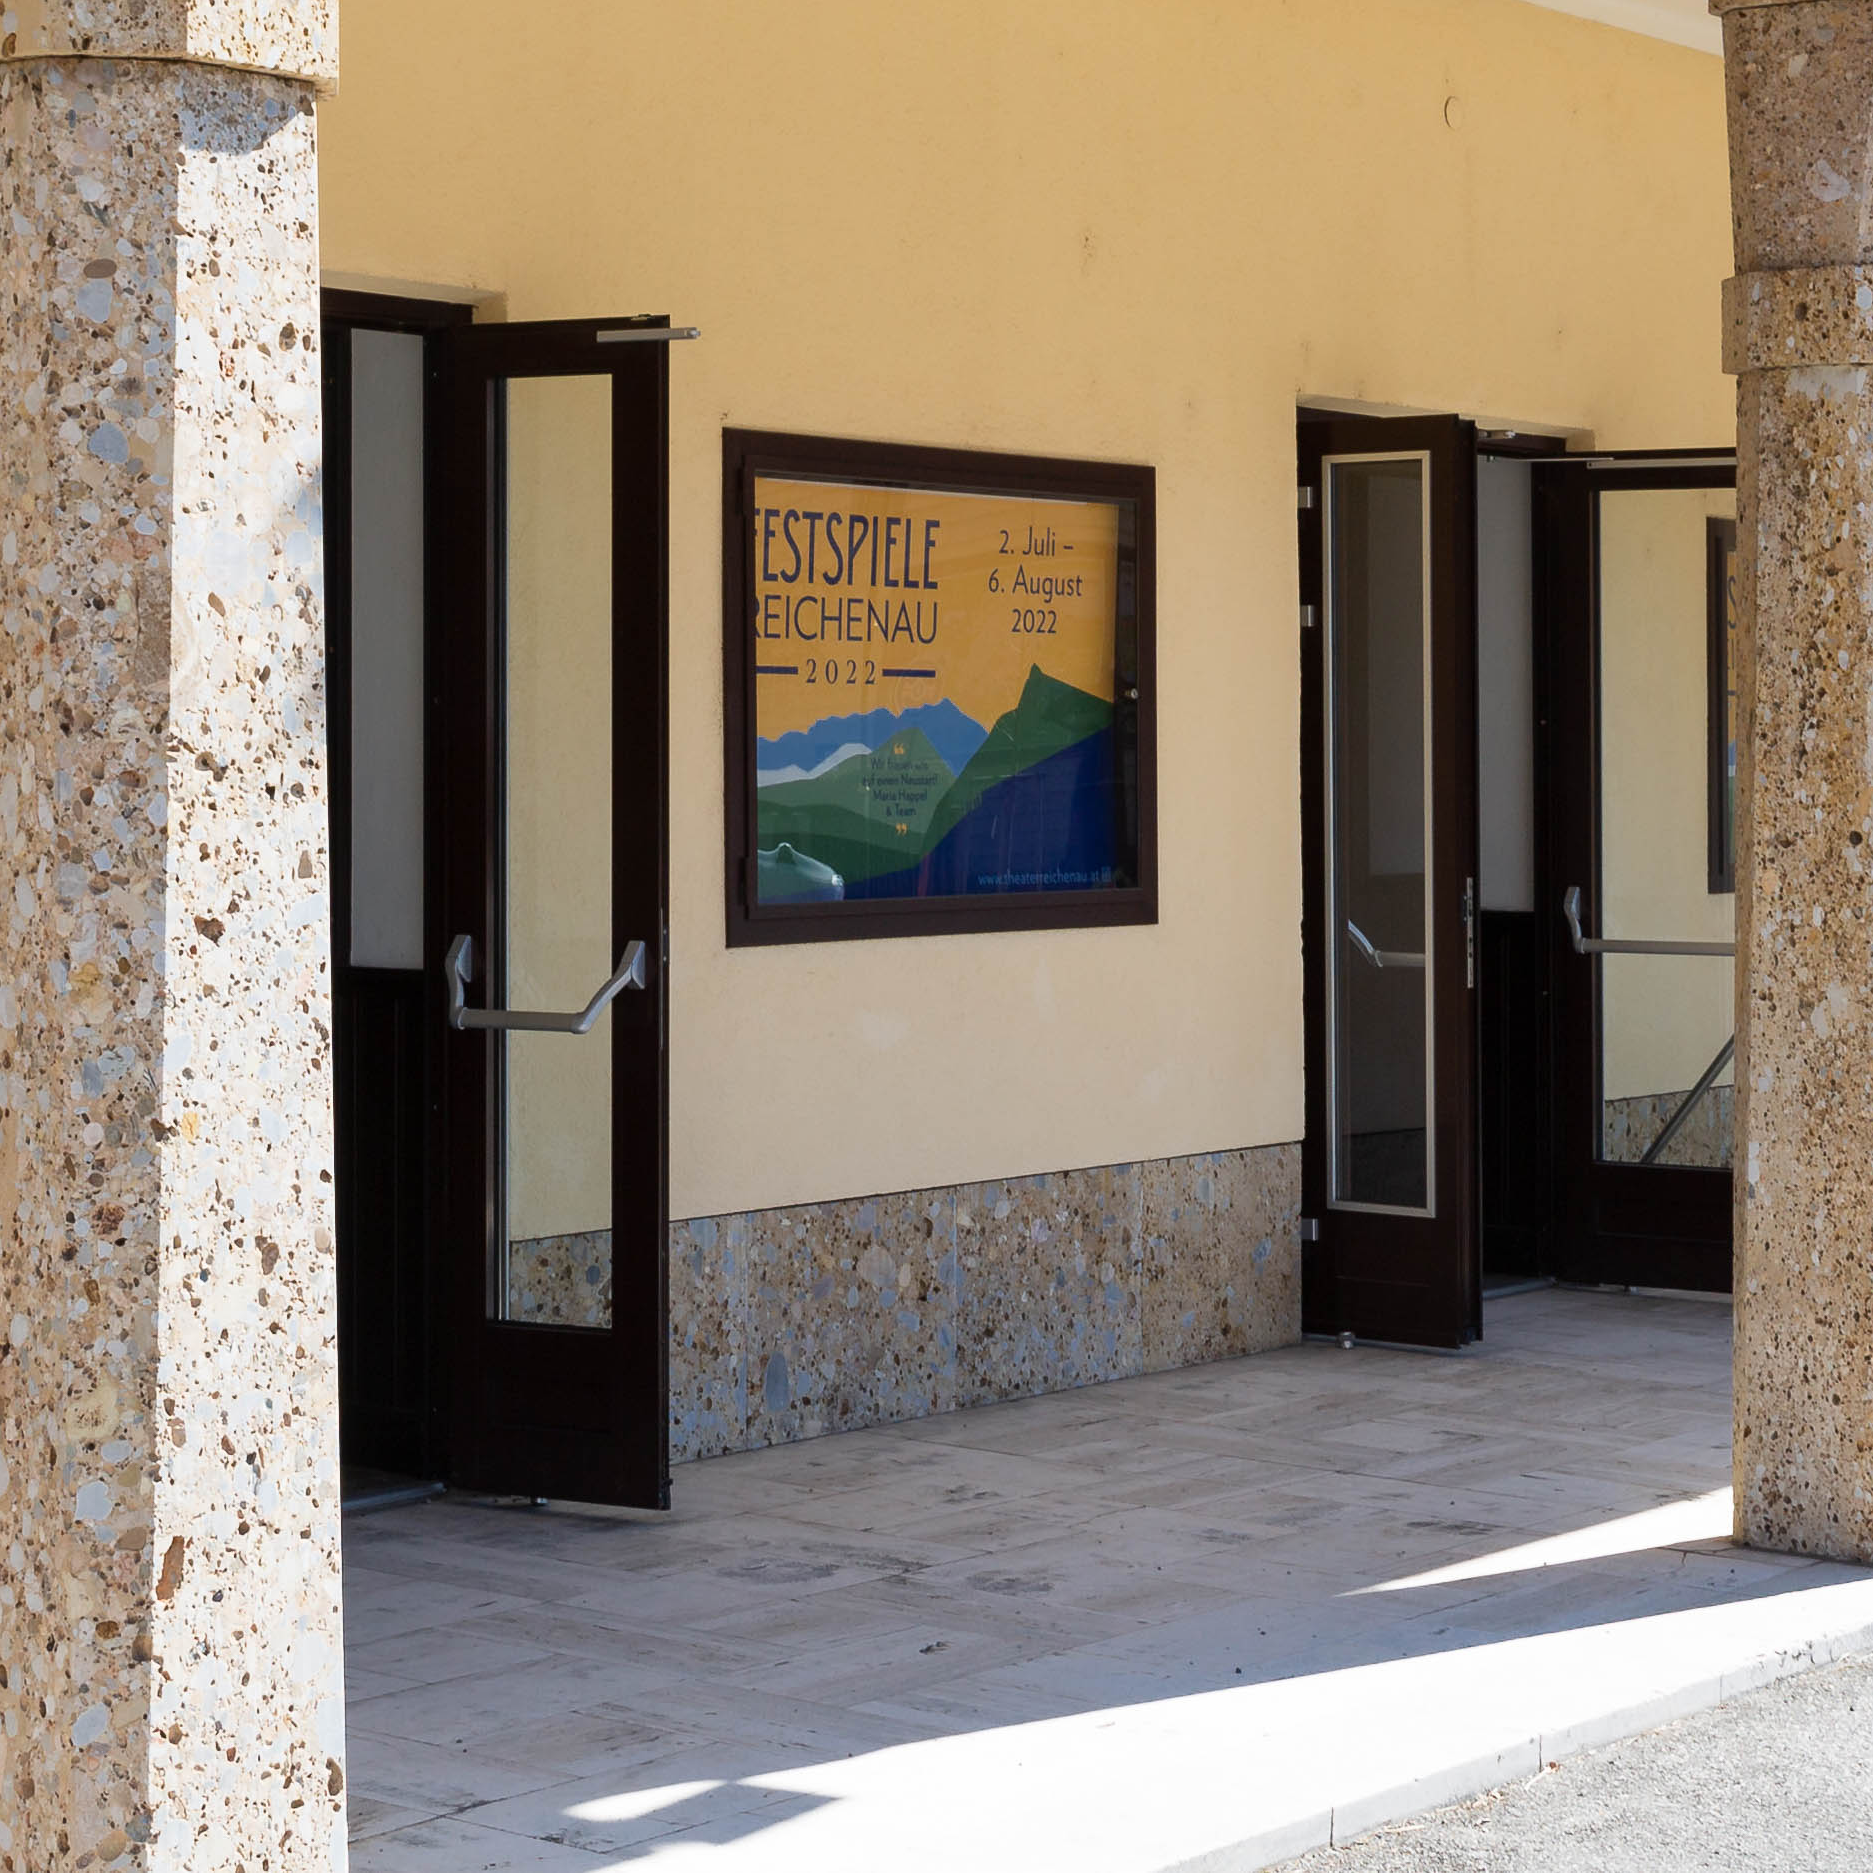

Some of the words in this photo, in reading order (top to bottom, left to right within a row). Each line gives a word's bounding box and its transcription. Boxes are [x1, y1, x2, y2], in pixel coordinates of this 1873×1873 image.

[754, 508, 941, 590] ESTSPIELE
[998, 529, 1015, 554] 2.
[1022, 526, 1056, 557] Juli
[988, 568, 1005, 594] 6.
[1012, 564, 1083, 604] August
[1010, 608, 1058, 634] 2022
[805, 658, 877, 685] 2022
